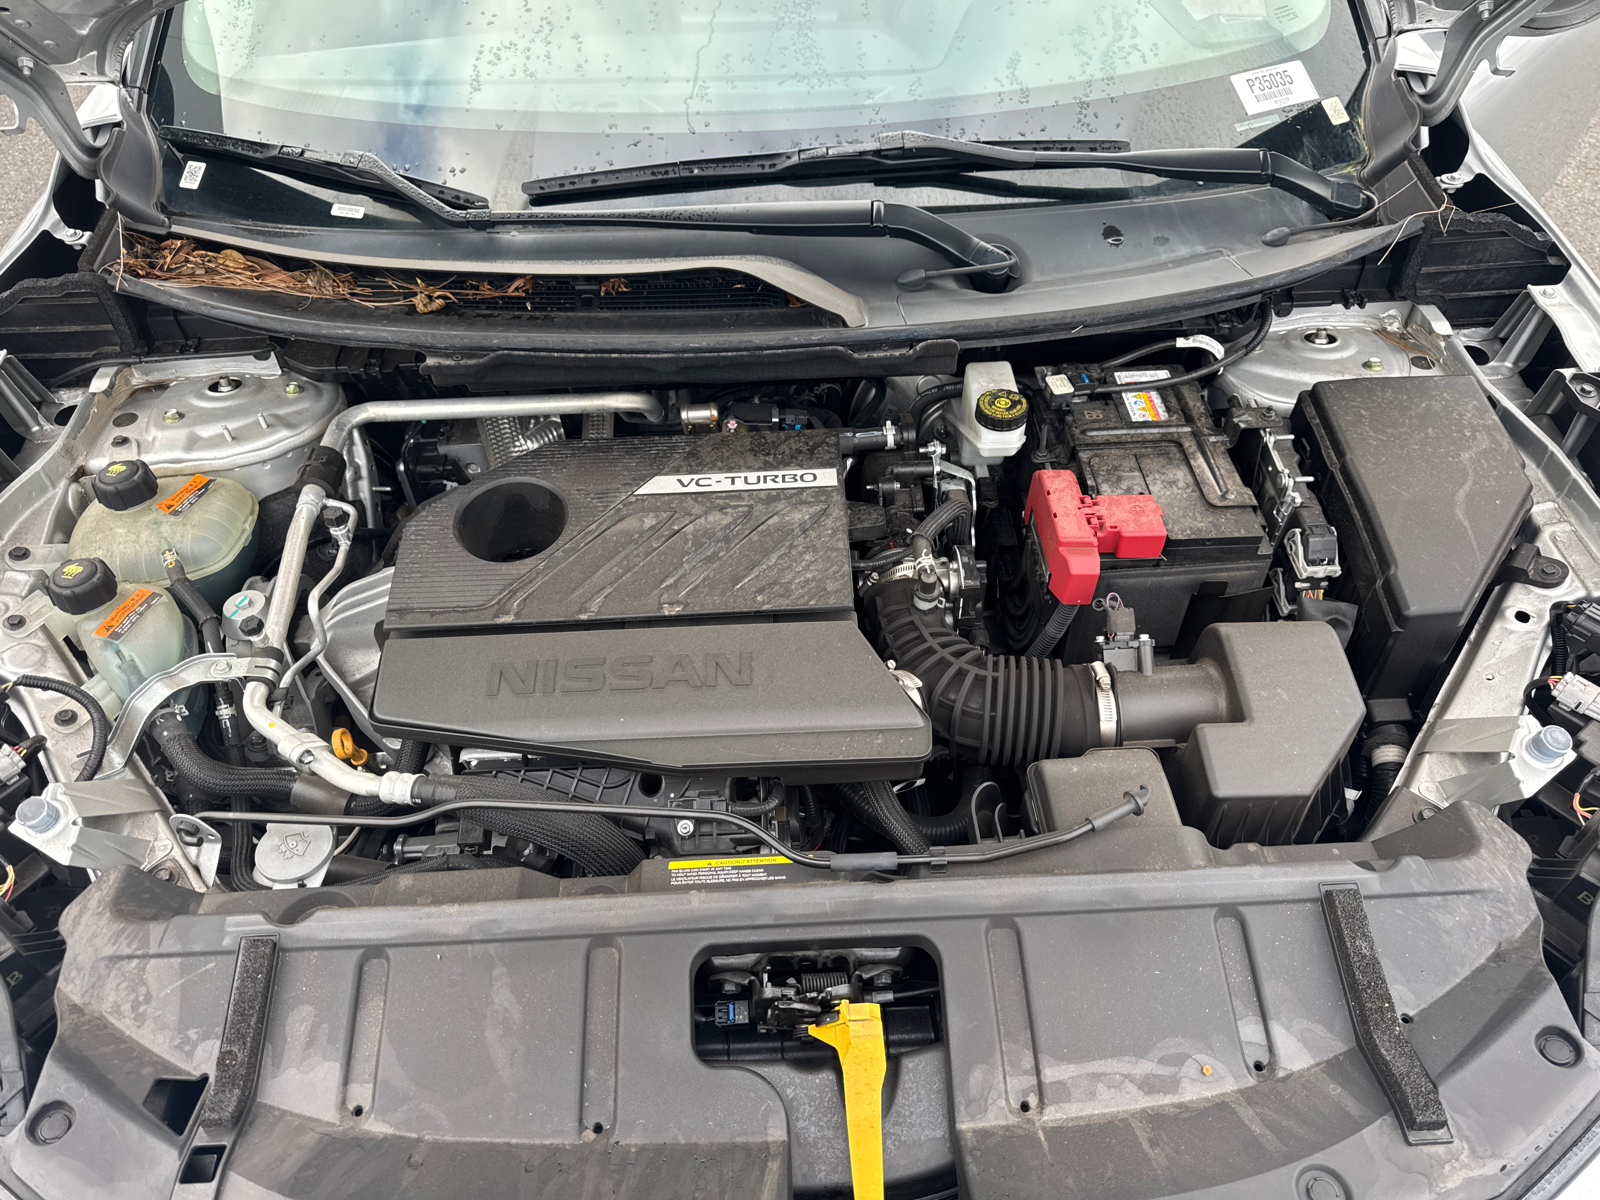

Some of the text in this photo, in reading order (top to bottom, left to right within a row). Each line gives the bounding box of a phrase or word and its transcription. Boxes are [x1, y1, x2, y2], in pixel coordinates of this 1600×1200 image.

[1246, 70, 1294, 94] P35035
[676, 472, 818, 488] VC-TURBO
[486, 651, 753, 697] NISSAN
[1577, 891, 1595, 905] B
[6, 970, 24, 986] B
